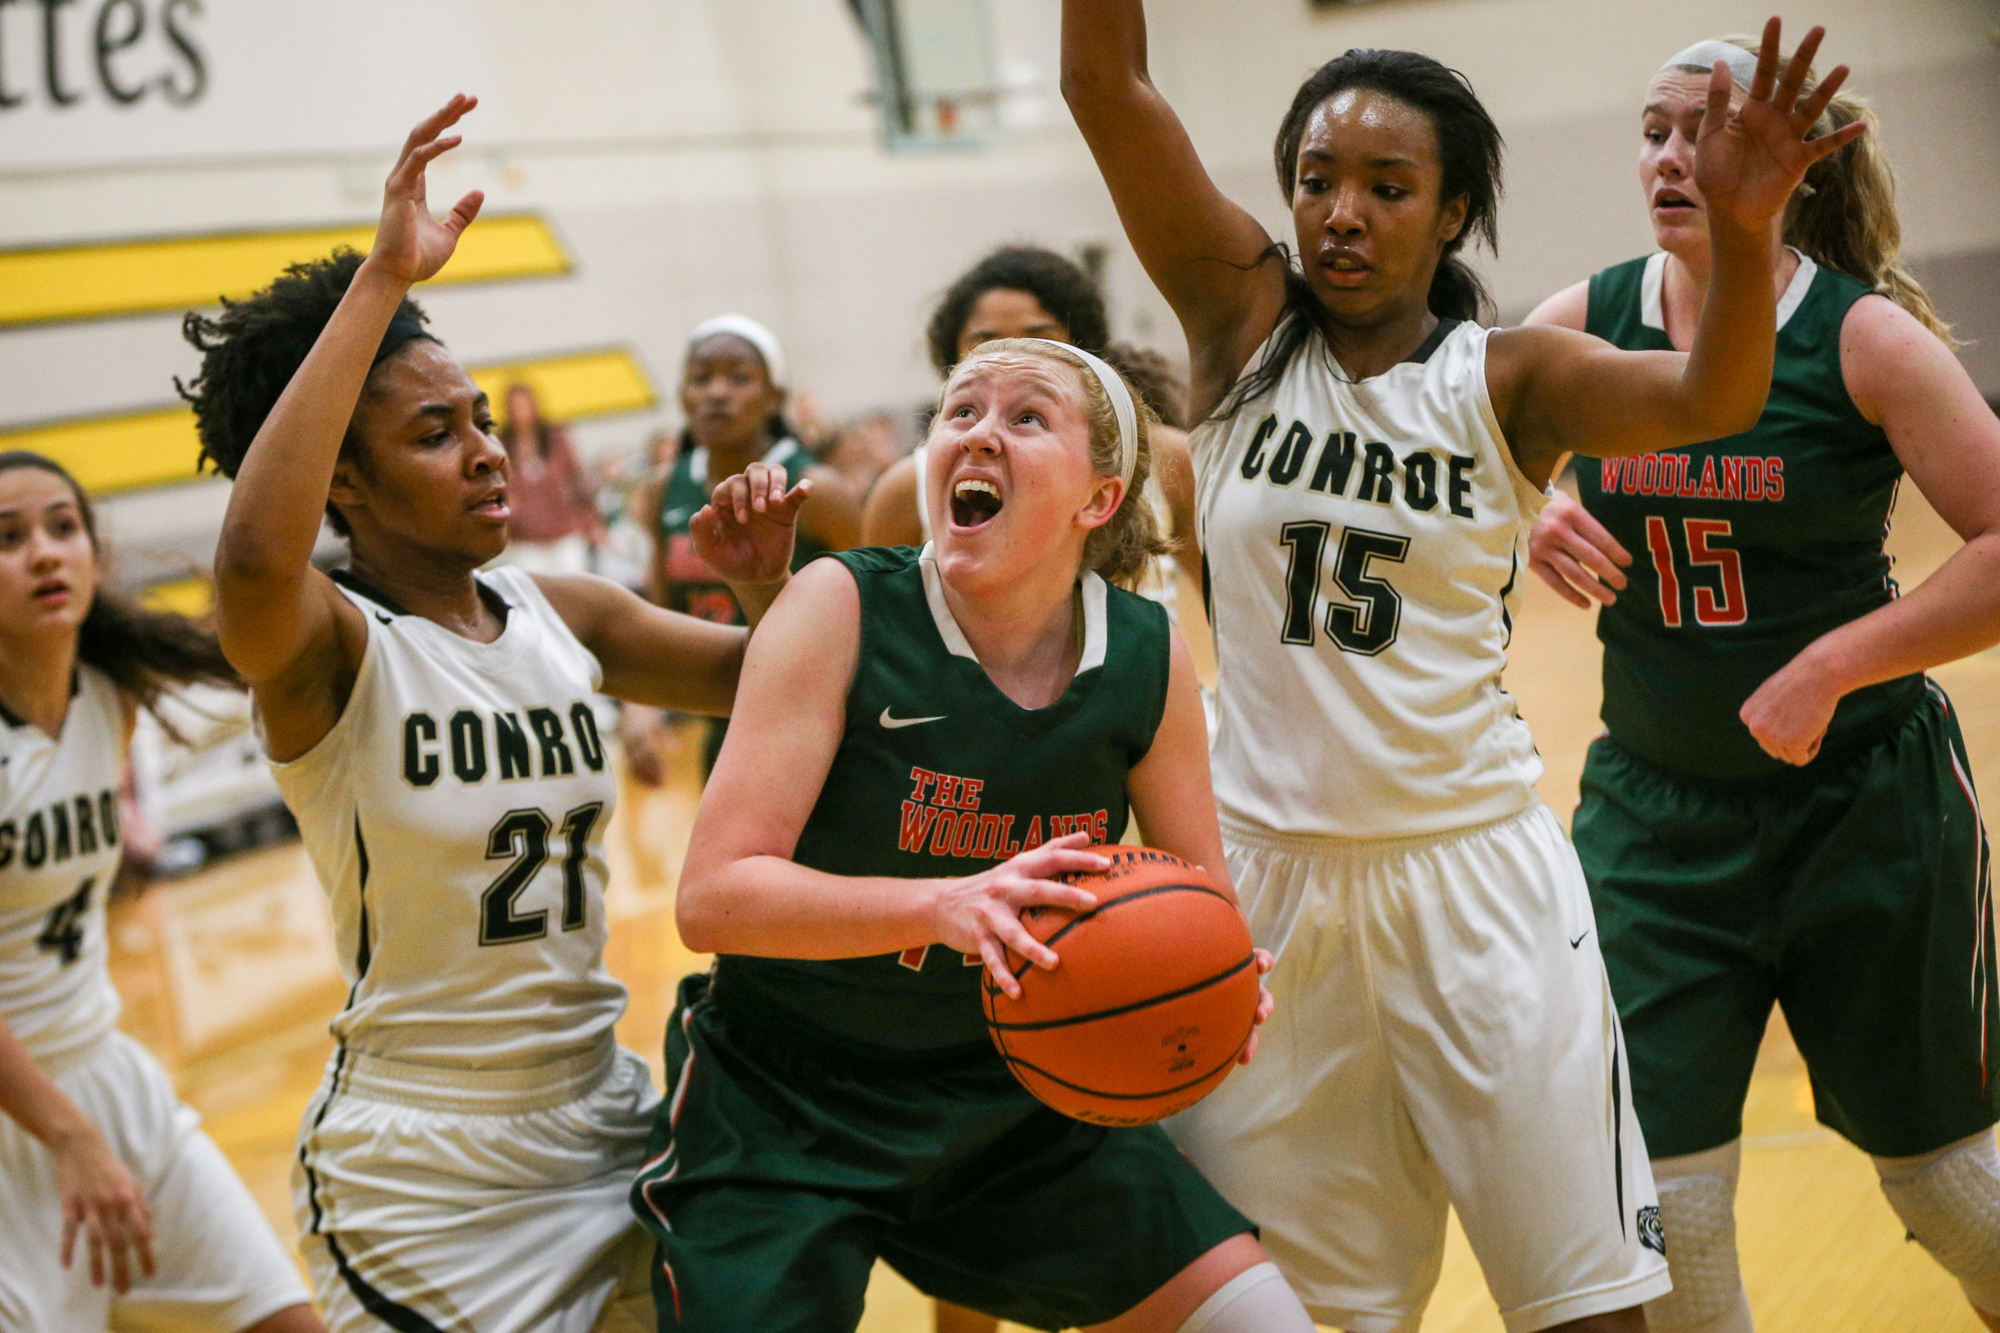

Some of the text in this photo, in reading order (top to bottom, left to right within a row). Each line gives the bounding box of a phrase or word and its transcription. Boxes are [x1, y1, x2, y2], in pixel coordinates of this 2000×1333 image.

[1239, 410, 1477, 521] CONROE
[1601, 453, 1785, 501] WOODLANDS
[1280, 520, 1411, 657] 15
[1645, 516, 1748, 628] 15
[401, 700, 607, 791] CONRO
[909, 765, 984, 811] THE
[36, 876, 98, 966] 4
[478, 801, 603, 947] 21
